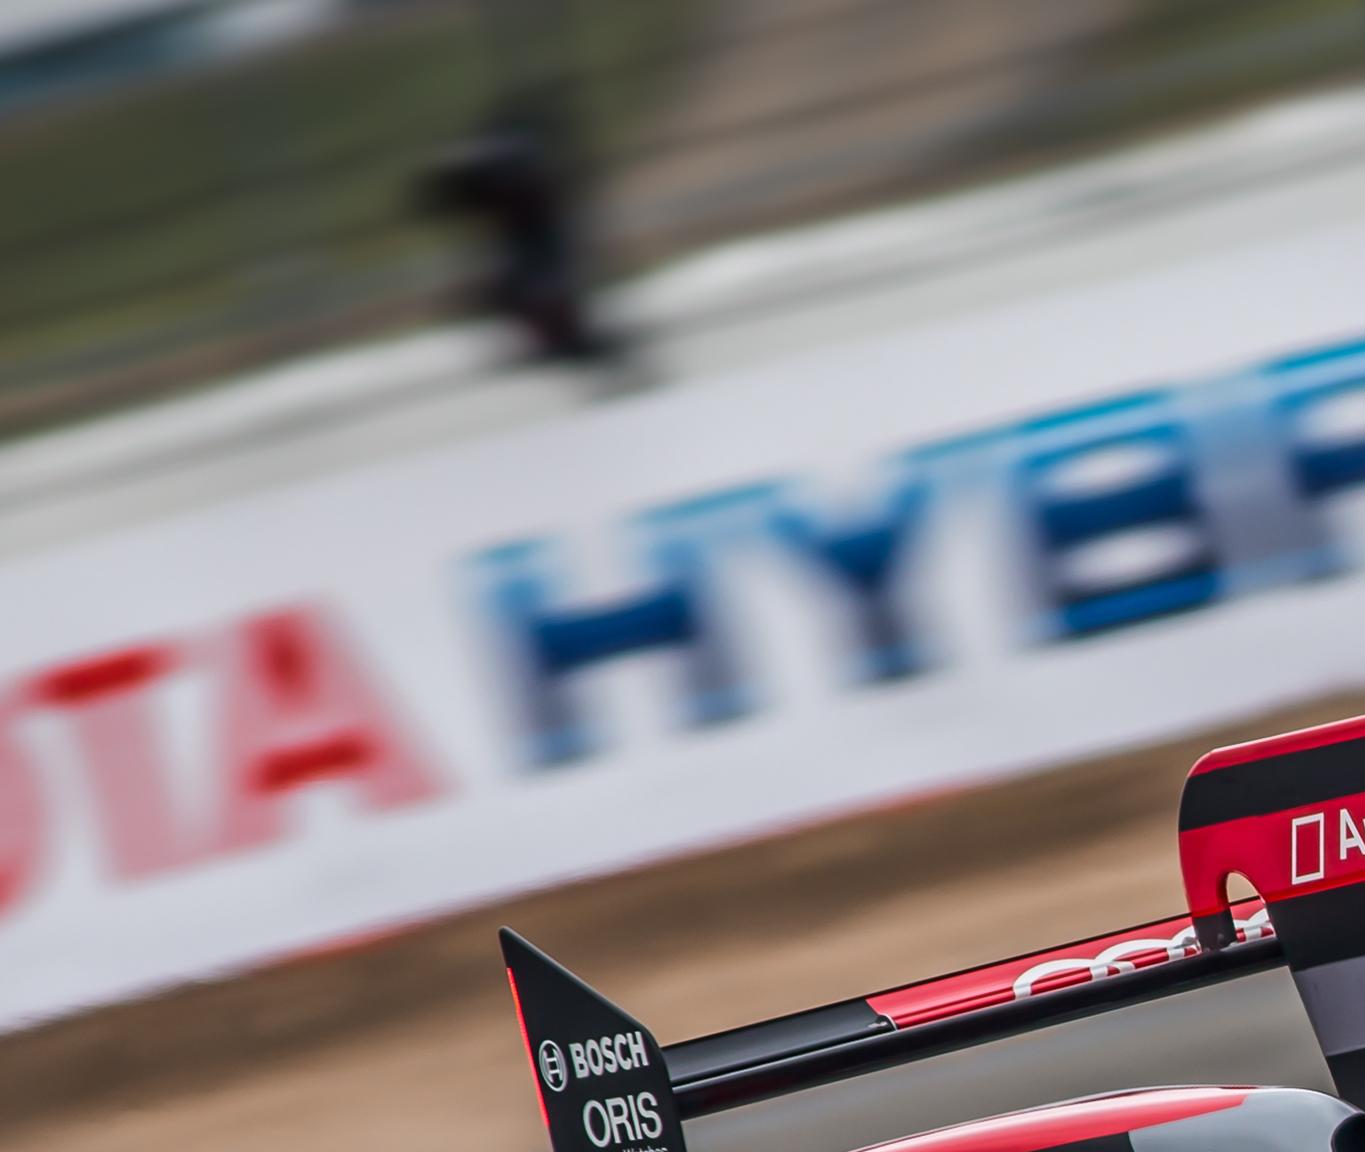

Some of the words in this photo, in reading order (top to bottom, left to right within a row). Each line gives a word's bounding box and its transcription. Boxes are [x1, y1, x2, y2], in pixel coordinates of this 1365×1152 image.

[0, 608, 450, 925] TA
[569, 1031, 649, 1079] BOSCH
[583, 1091, 663, 1148] ORIS
